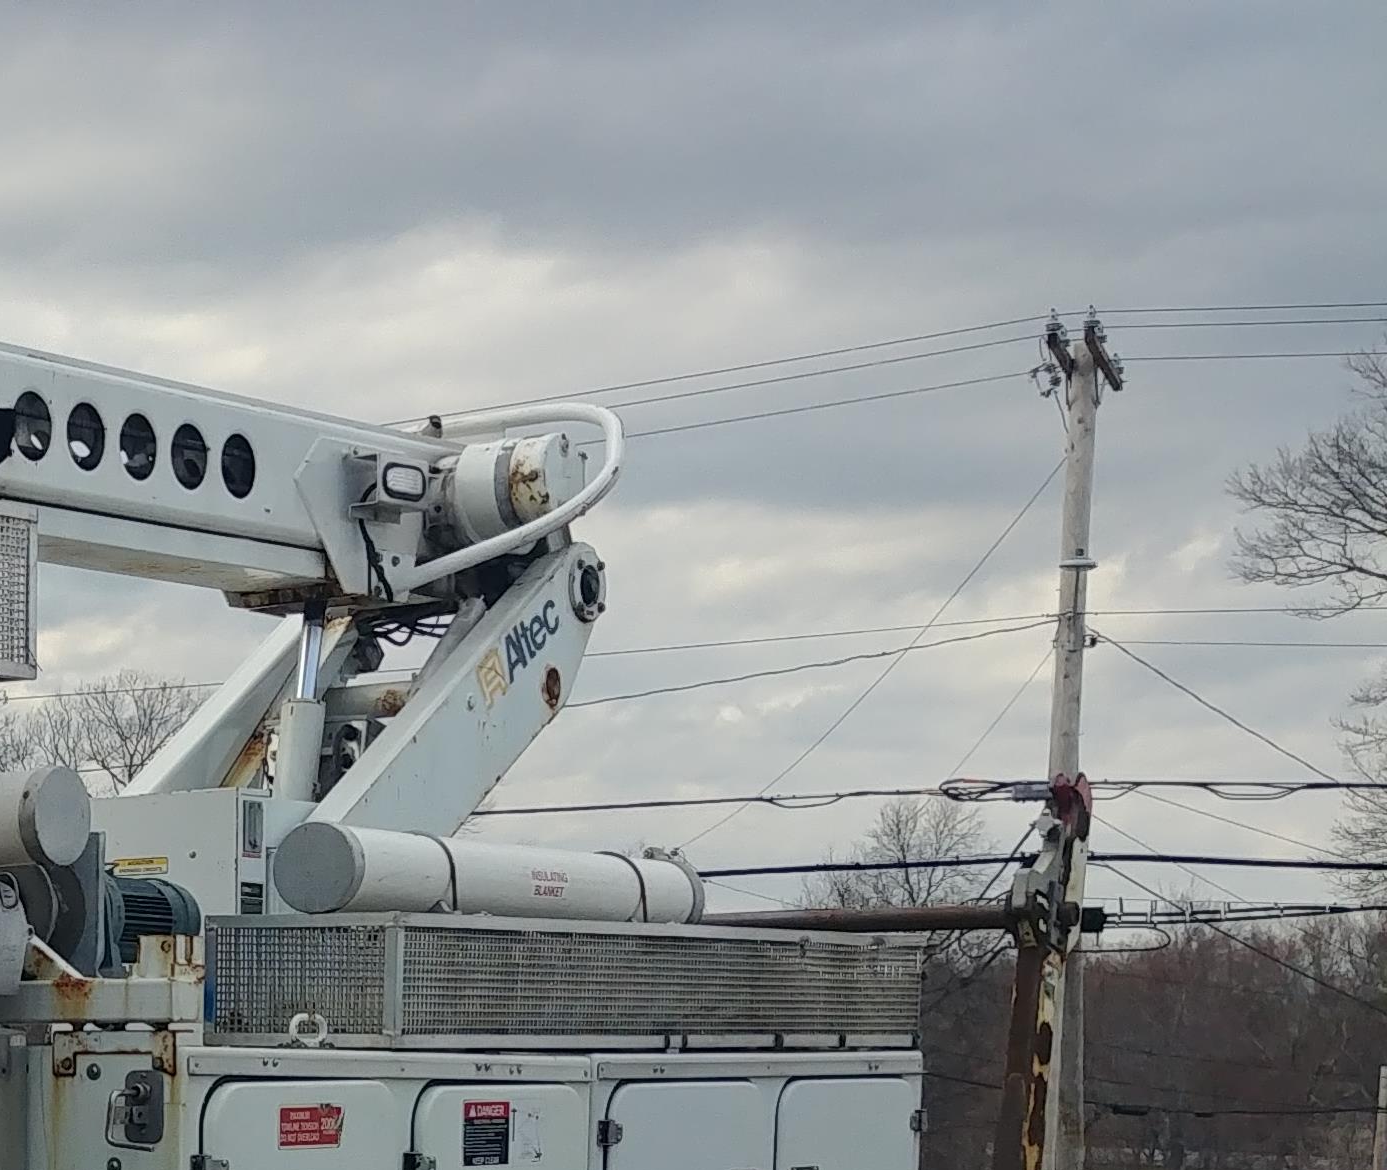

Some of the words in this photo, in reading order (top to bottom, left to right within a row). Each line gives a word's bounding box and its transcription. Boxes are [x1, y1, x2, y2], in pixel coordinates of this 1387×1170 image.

[505, 599, 560, 685] Altec
[533, 885, 565, 897] BLANKET
[477, 1104, 505, 1118] DANGER
